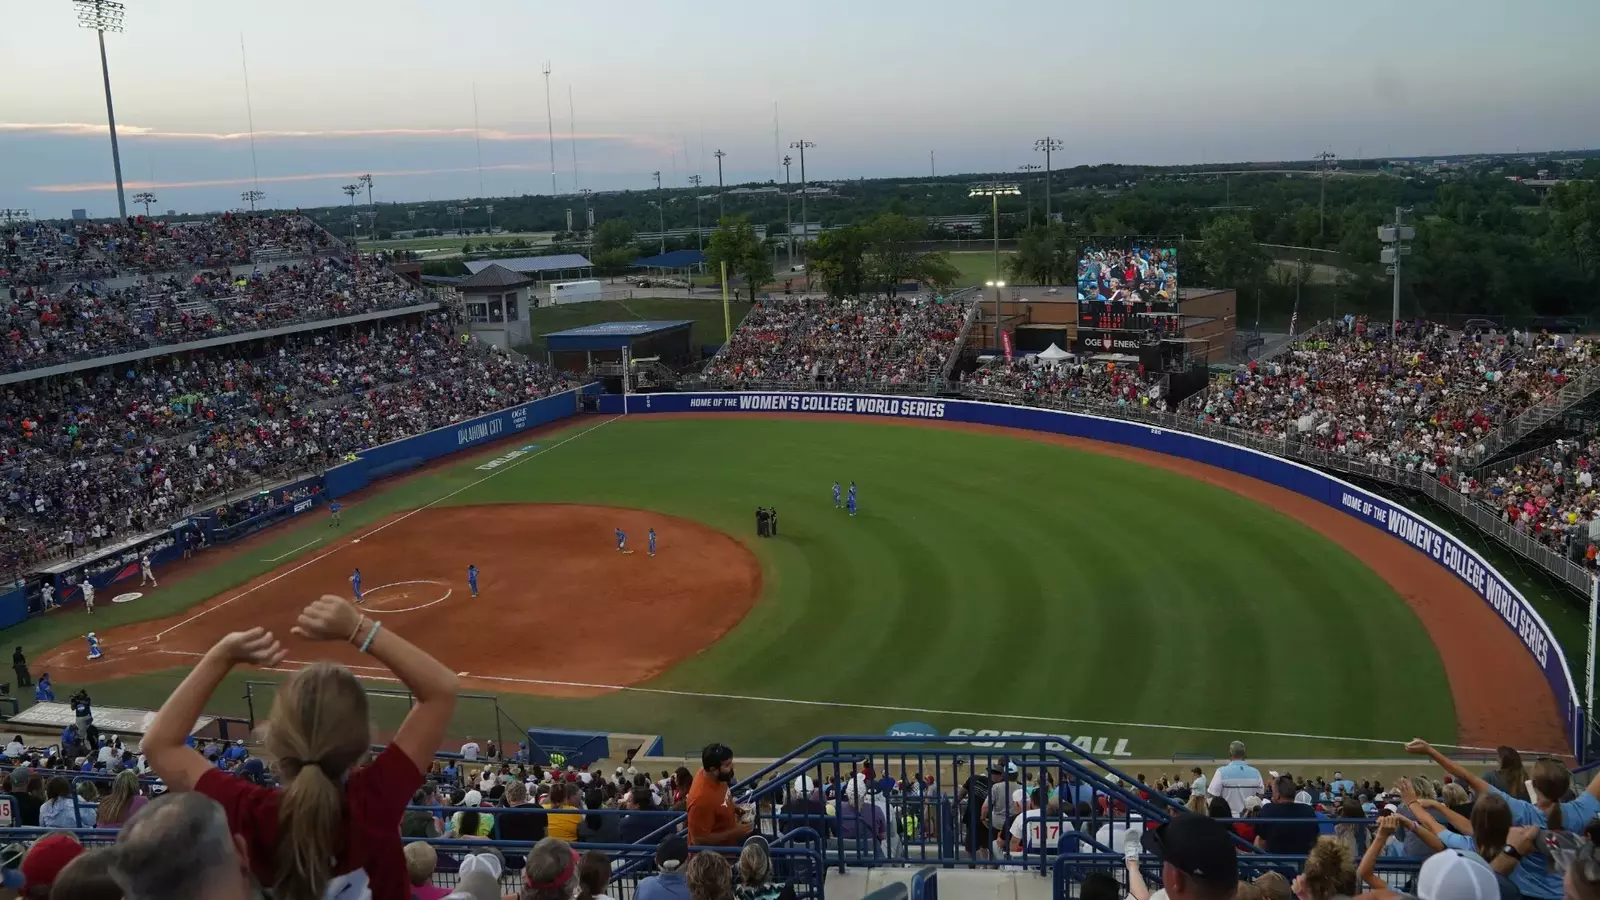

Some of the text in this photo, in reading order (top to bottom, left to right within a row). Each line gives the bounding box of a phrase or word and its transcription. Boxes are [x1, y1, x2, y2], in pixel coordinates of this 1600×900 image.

[1084, 338, 1102, 347] OGE
[690, 395, 945, 418] HOME OF THE WOMEN'S COLLEGE WORLD SERIES
[457, 418, 503, 445] OKLAHOMA CITY
[293, 499, 312, 512] ESPN
[1342, 492, 1362, 512] HOME
[1363, 501, 1373, 516] OF
[1373, 505, 1387, 523] THE
[1388, 508, 1442, 559] WOMEN'S
[1443, 541, 1485, 594] COLLEGE
[1485, 574, 1520, 629] WORLD
[1519, 611, 1548, 669] SERIES
[945, 728, 1132, 756] SOFTBALL
